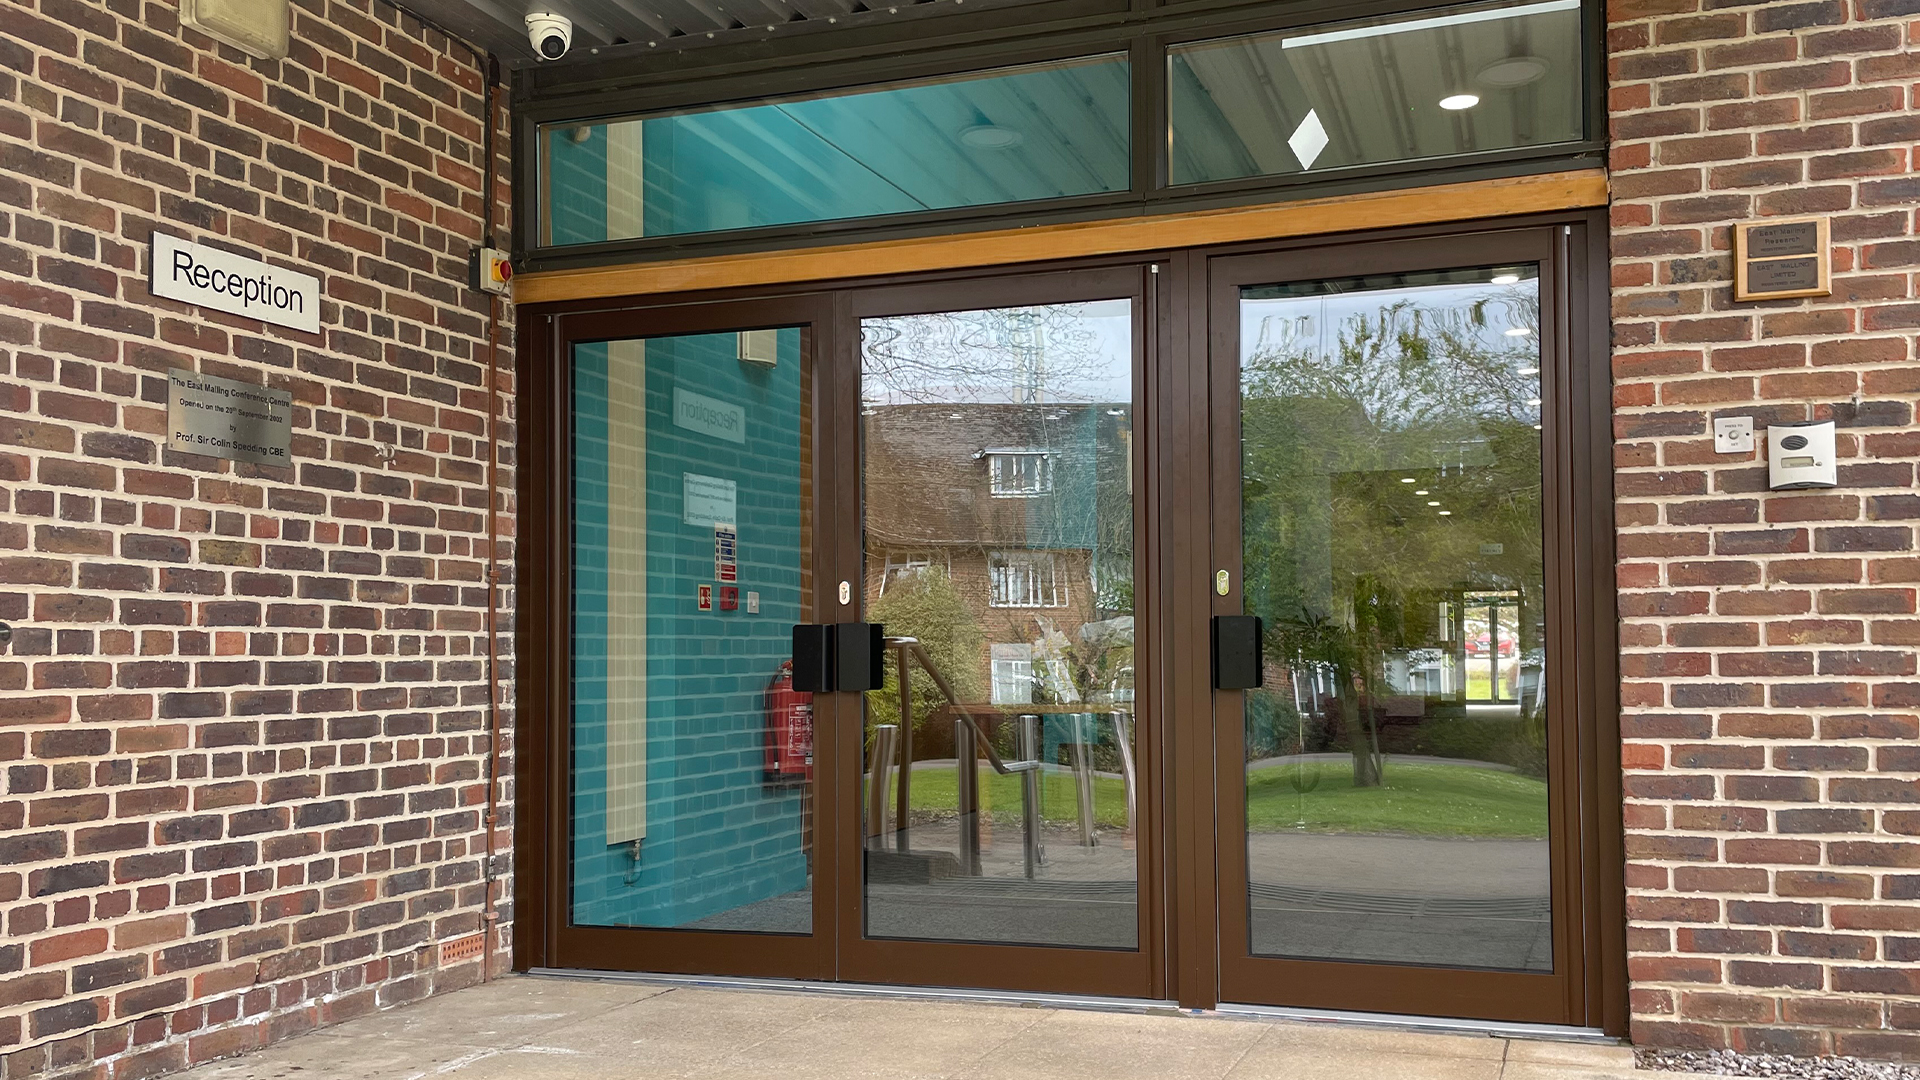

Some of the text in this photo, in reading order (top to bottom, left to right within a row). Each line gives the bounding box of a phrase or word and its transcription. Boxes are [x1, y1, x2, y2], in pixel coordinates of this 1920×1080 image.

[173, 249, 303, 314] Reception
[171, 376, 290, 408] The East Malling Conference Centre
[179, 398, 204, 409] Opened
[214, 403, 225, 413] the
[238, 408, 269, 421] September
[269, 414, 283, 423] 2002
[229, 424, 237, 433] by
[175, 431, 285, 457] Prof. Sir Colin Spedding CBE
